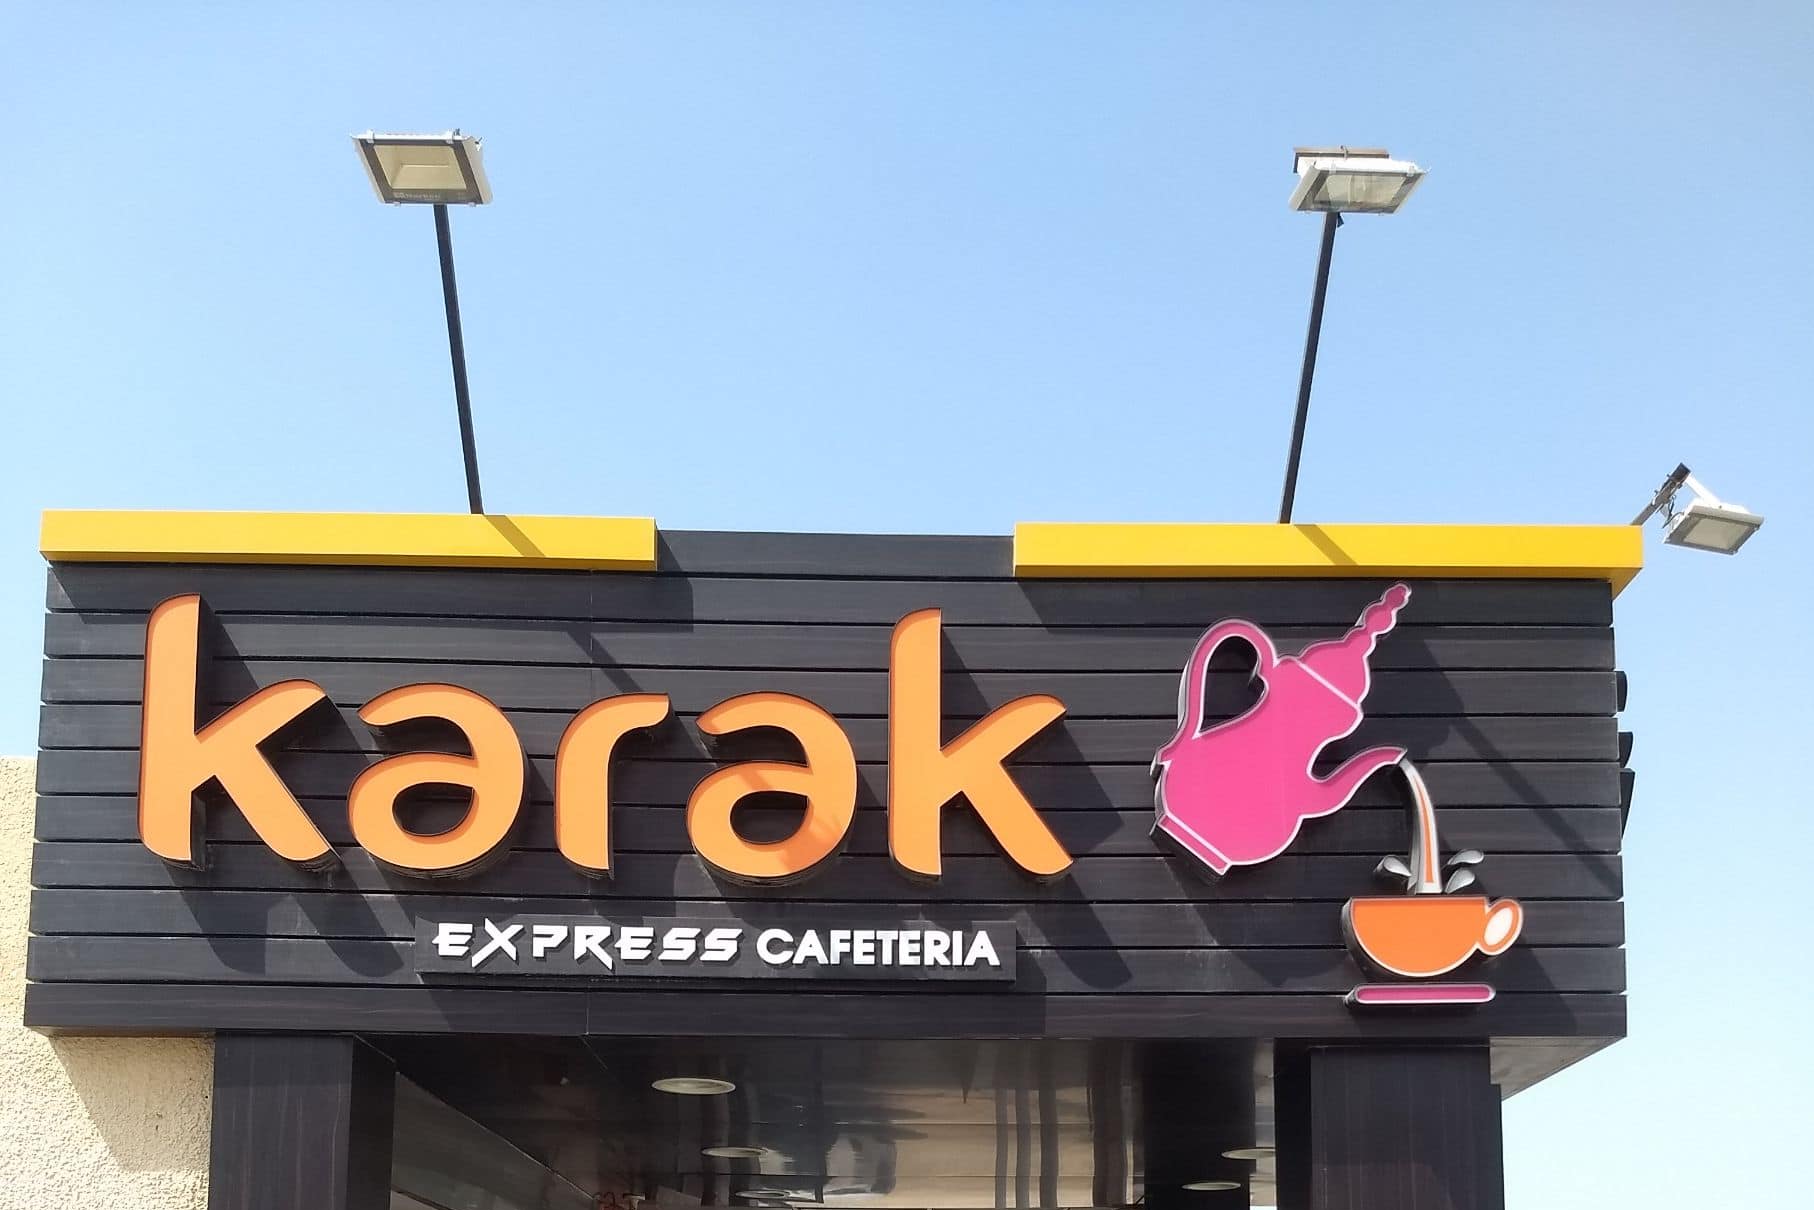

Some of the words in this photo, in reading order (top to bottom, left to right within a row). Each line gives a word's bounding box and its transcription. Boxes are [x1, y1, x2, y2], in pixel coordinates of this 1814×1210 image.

[137, 592, 1074, 881] karak
[432, 917, 743, 971] EXPRESS
[756, 928, 1000, 967] CAFETERIA
